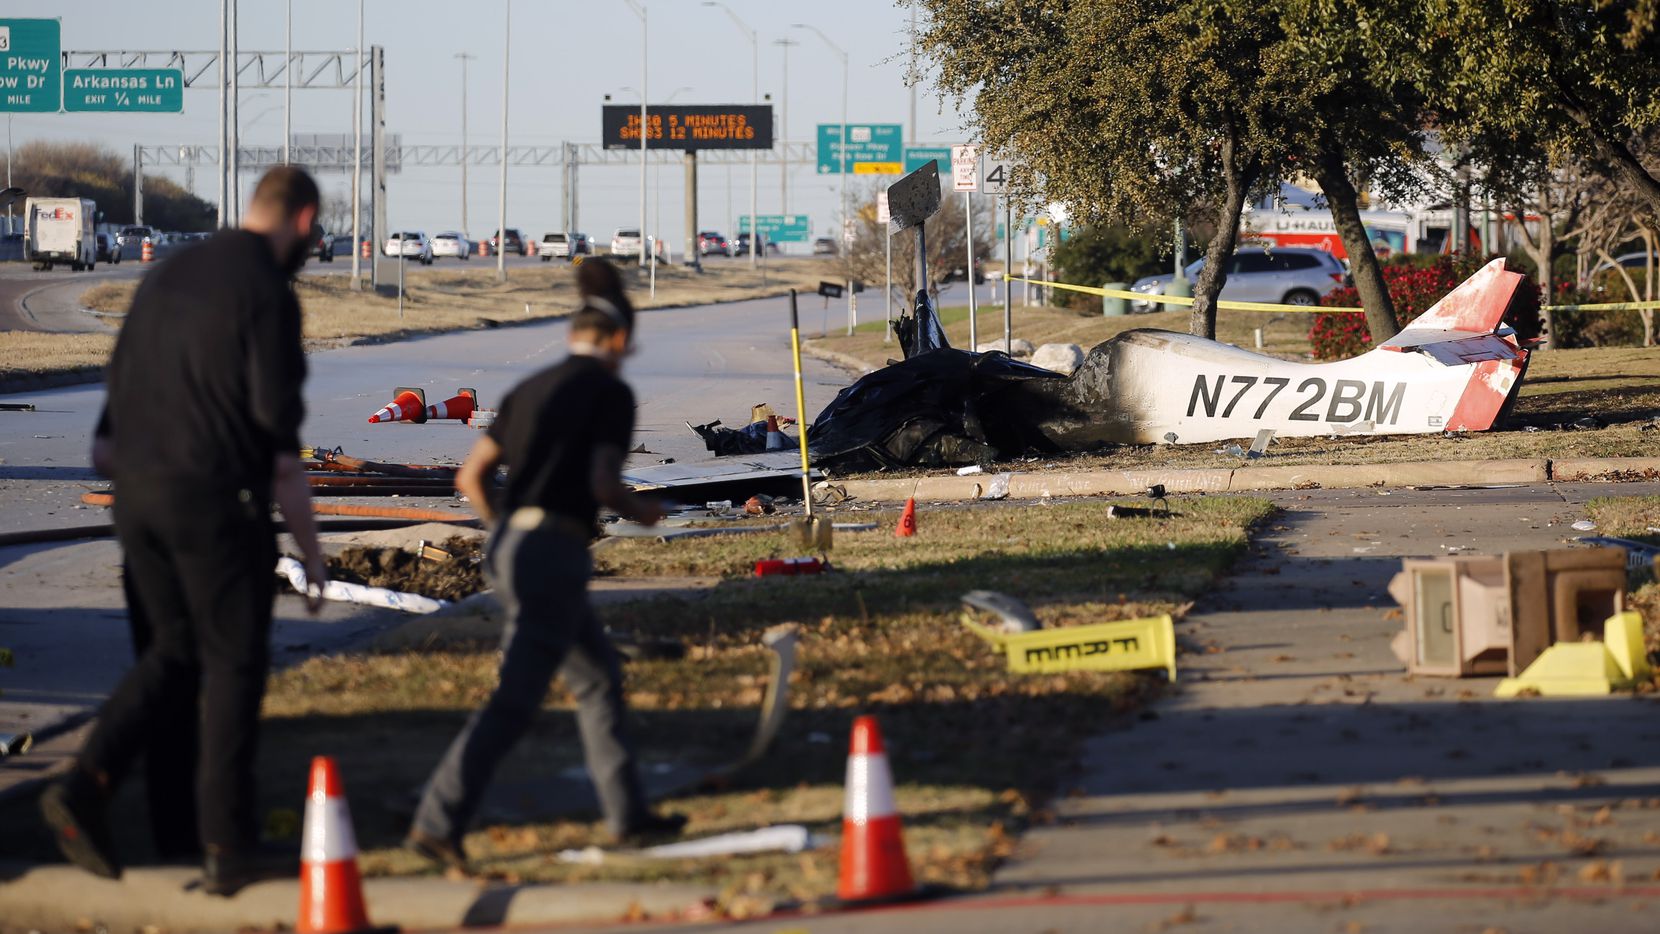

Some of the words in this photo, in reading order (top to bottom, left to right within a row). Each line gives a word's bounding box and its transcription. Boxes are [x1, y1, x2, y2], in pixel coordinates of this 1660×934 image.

[8, 56, 50, 73] Pkwy
[27, 75, 46, 88] Dr
[73, 75, 148, 88] Arkansas
[155, 75, 175, 88] Ln
[8, 95, 31, 104] MILE
[85, 95, 106, 104] EXIT
[138, 95, 162, 104] MILE
[685, 114, 747, 127] MINUTES
[619, 126, 663, 139] SH83
[670, 126, 686, 139] 12
[692, 126, 755, 139] MINUTES
[35, 208, 73, 221] FedEx
[1186, 374, 1407, 425] N772BM
[1025, 637, 1138, 663] FREE
